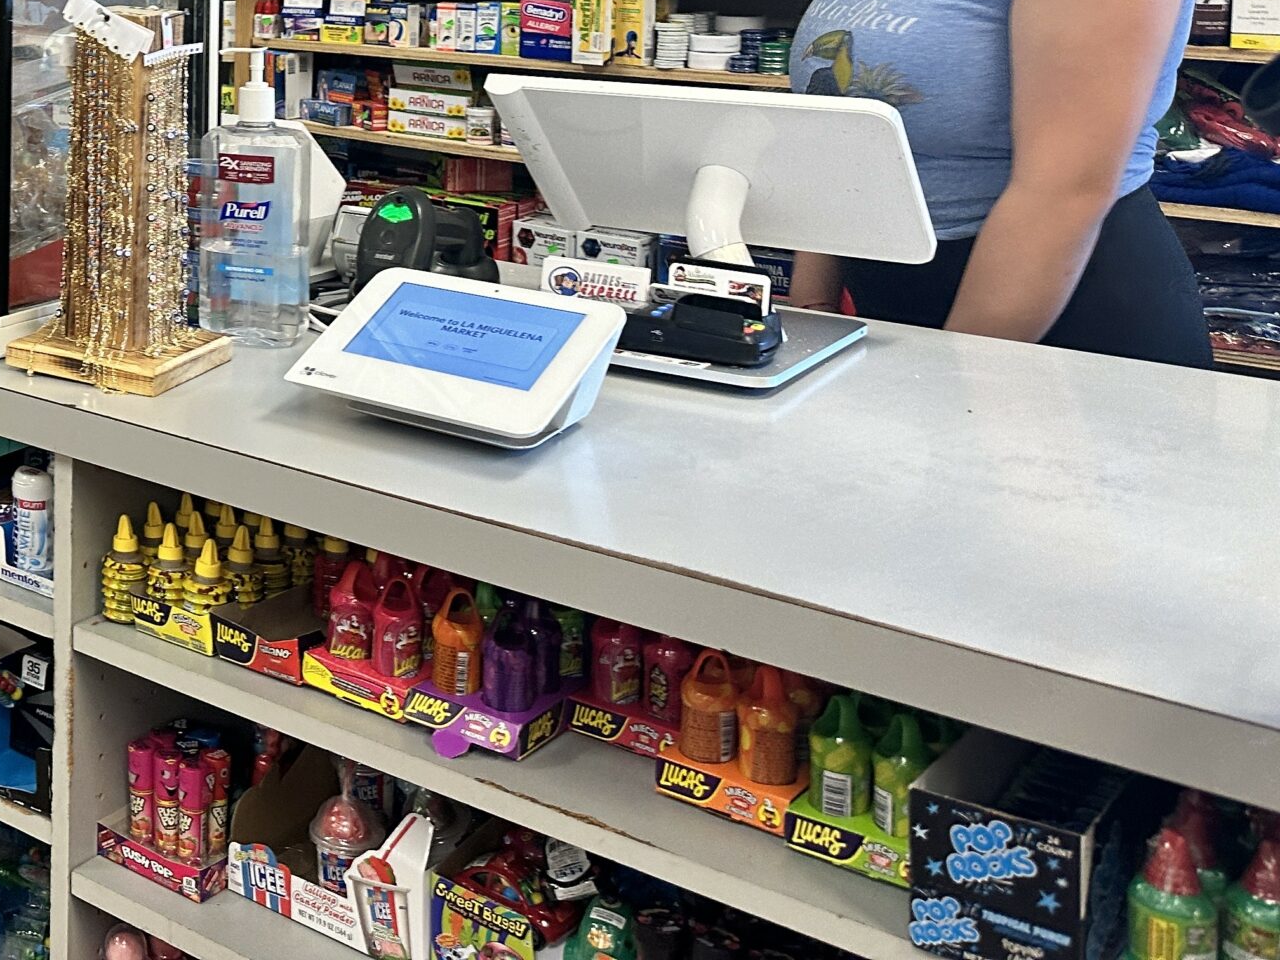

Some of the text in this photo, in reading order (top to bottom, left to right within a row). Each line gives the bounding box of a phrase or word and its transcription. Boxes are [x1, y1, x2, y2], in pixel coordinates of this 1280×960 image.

[525, 4, 564, 21] Benadryl
[526, 20, 560, 33] ALLERGY
[412, 73, 451, 84] ARNICA
[225, 202, 265, 220] Purell
[399, 308, 446, 324] Welcome
[459, 321, 475, 329] LA
[476, 324, 544, 342] MIGUELENA
[440, 325, 487, 339] MARKET
[1, 567, 40, 589] mentos
[130, 595, 165, 623] LUCAS
[217, 622, 252, 652] LUCAS
[27, 659, 41, 675] 35
[407, 693, 451, 723] LUCAS
[572, 705, 616, 729] LUCAS
[660, 764, 709, 798] LUCAS
[793, 819, 846, 855] LUCAS
[950, 820, 1012, 855] POP
[1036, 842, 1073, 859] COUNT
[121, 846, 174, 878] PUSH POP
[946, 846, 1038, 883] ROCKS
[247, 858, 286, 897] ICEE
[304, 883, 338, 906] Lollipop
[294, 893, 356, 927] Candy Powder
[374, 901, 391, 920] ICEE
[483, 908, 527, 937] Buggy
[912, 897, 961, 922] POP
[909, 918, 980, 945] ROCKS
